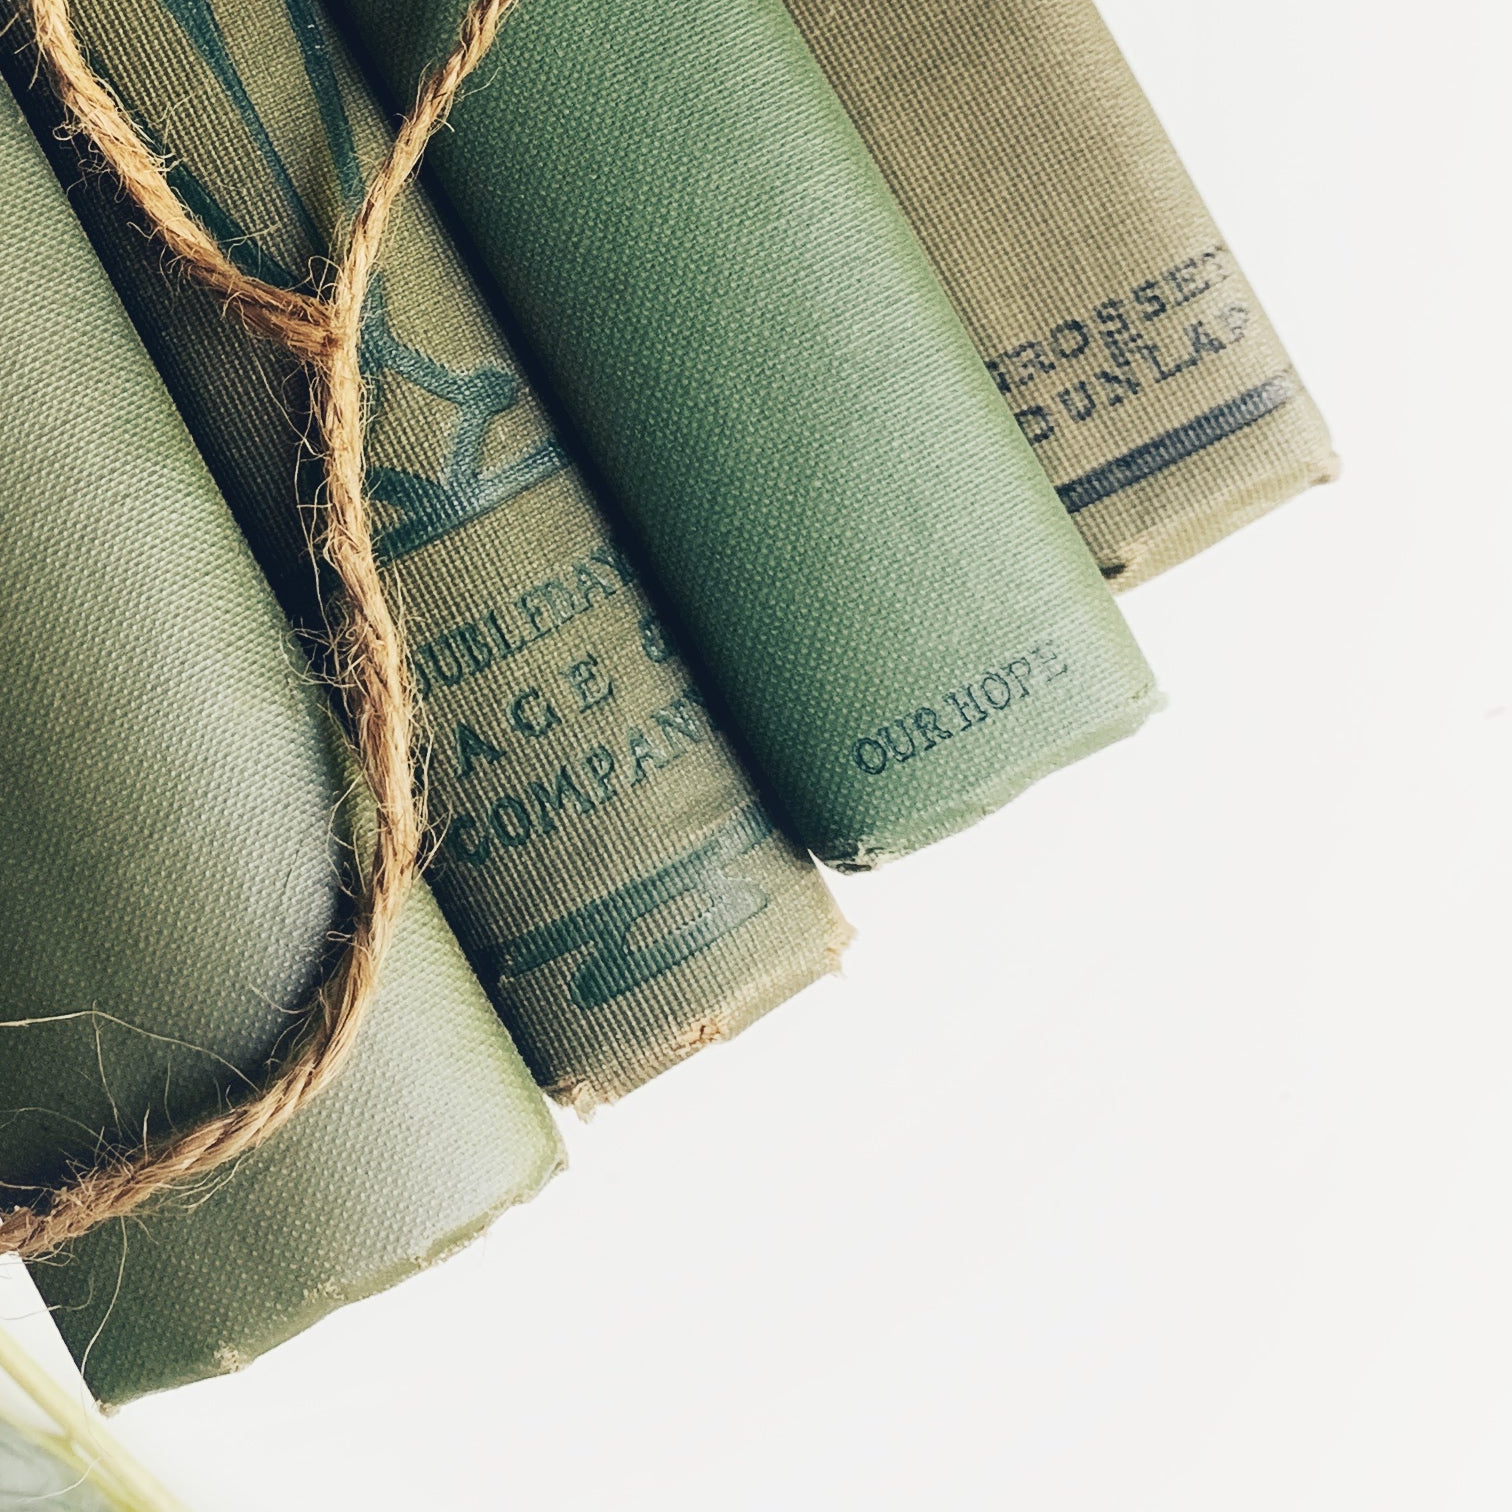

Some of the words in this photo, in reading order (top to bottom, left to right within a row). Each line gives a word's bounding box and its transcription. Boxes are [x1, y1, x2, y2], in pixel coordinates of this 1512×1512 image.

[416, 546, 635, 699] UBLEDAY
[410, 654, 615, 790] AGE
[852, 706, 954, 775] OUR
[944, 639, 1068, 731] HOPE
